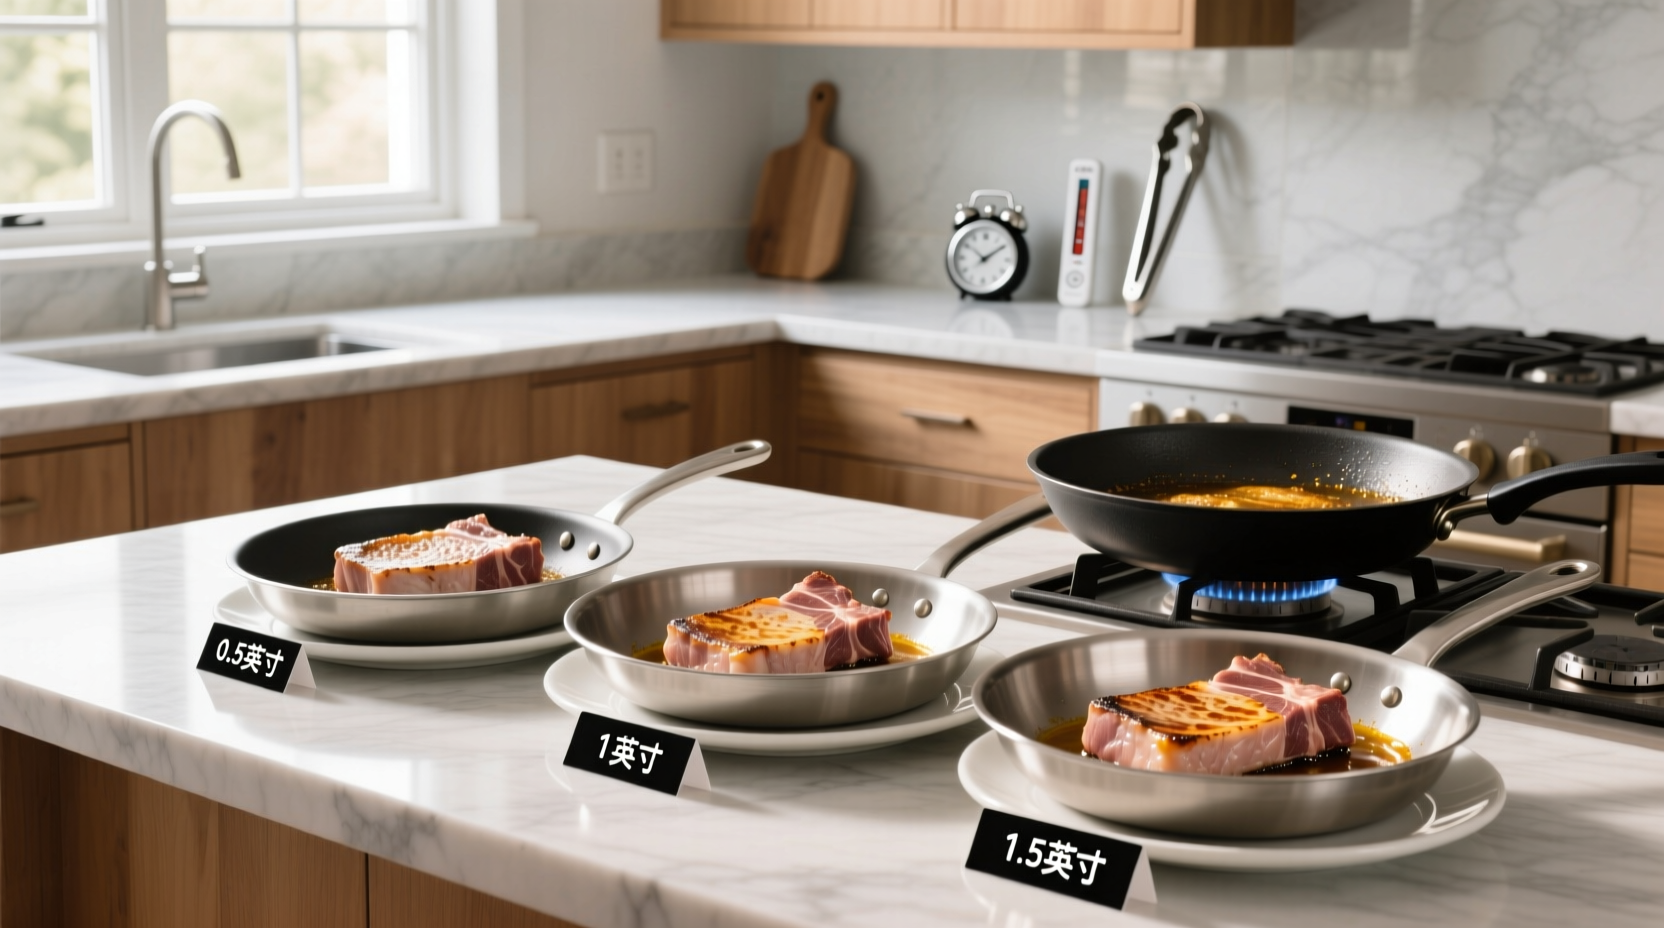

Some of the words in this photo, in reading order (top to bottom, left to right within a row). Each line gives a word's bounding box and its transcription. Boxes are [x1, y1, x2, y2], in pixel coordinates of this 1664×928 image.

[216, 638, 285, 678] 0.5英寸
[599, 733, 664, 775] 1英寸
[1005, 832, 1107, 886] 1.5英寸
